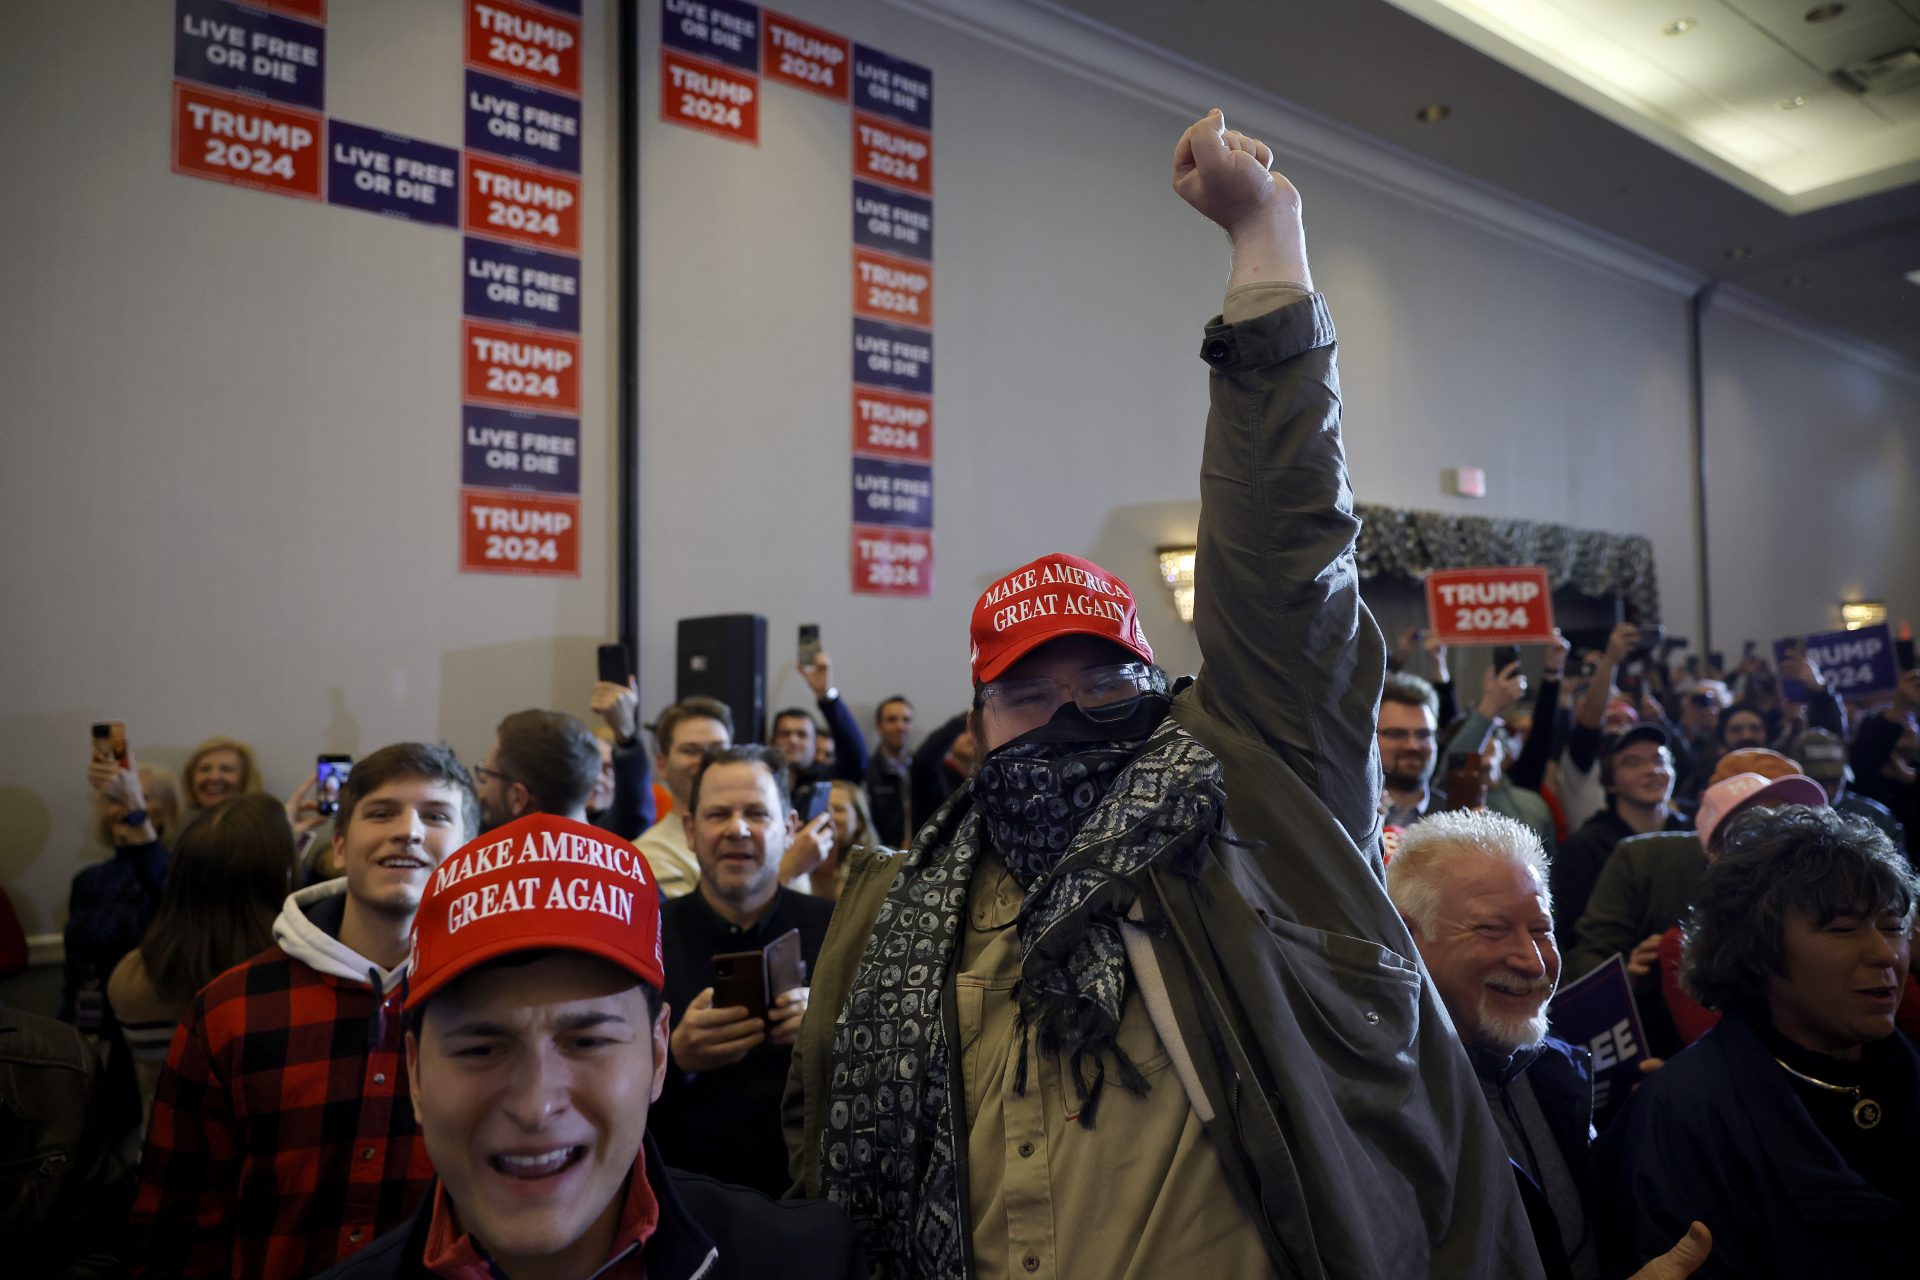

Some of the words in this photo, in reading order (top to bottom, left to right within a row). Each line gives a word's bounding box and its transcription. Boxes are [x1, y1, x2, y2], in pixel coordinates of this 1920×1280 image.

[475, 3, 573, 50] TRUMP
[666, 0, 706, 21] LIVE
[711, 9, 754, 37] FREE
[681, 19, 707, 41] OR
[711, 28, 741, 50] DIE
[183, 14, 245, 47] LIVE
[252, 32, 318, 66] FREE
[488, 36, 560, 76] 2024
[771, 24, 843, 64] TRUMP
[206, 44, 246, 70] OR
[252, 54, 296, 82] DIE
[780, 53, 833, 87] 2024
[856, 61, 889, 83] LIVE
[893, 73, 928, 98] FREE
[669, 64, 752, 104] TRUMP
[868, 82, 889, 102] OR
[893, 91, 917, 111] DIE
[187, 102, 312, 150] TRUMP
[470, 90, 518, 120] LIVE
[523, 107, 576, 136] FREE
[681, 94, 741, 128] 2024
[488, 118, 519, 141] OR
[524, 127, 560, 150] DIE
[860, 125, 926, 160] TRUMP
[204, 139, 295, 180] 2024
[334, 142, 389, 172] LIVE
[395, 158, 454, 188] FREE
[868, 151, 917, 181] 2024
[355, 169, 390, 196] OR
[396, 178, 435, 204] DIE
[473, 169, 572, 211] TRUMP
[487, 200, 559, 236] 2024
[856, 197, 889, 219] LIVE
[893, 207, 928, 230] FREE
[868, 217, 889, 236] OR
[893, 225, 917, 243] DIE
[469, 258, 518, 284] LIVE
[522, 269, 575, 295] FREE
[858, 262, 927, 292] TRUMP
[486, 282, 518, 305] OR
[523, 289, 558, 311] DIE
[868, 285, 918, 314] 2024
[472, 337, 572, 371] TRUMP
[856, 335, 889, 357] LIVE
[893, 342, 928, 363] FREE
[868, 354, 889, 373] OR
[893, 359, 918, 377] DIE
[487, 367, 558, 398] 2024
[858, 400, 927, 425] TRUMP
[468, 426, 516, 450] LIVE
[522, 433, 574, 456] FREE
[868, 423, 918, 449] 2024
[485, 449, 517, 470] OR
[523, 455, 558, 474] DIE
[856, 473, 889, 493] LIVE
[893, 478, 928, 497] FREE
[868, 493, 889, 510] OR
[893, 496, 918, 512] DIE
[471, 505, 571, 534] TRUMP
[485, 535, 557, 560] 2024
[858, 539, 926, 562] TRUMP
[868, 562, 918, 584] 2024
[983, 569, 1037, 609] MAKE
[1041, 563, 1131, 600] AMERICA
[1437, 581, 1539, 606] TRUMP
[993, 593, 1059, 632] GREAT
[1064, 593, 1126, 625] AGAIN
[1456, 606, 1529, 631] 2024
[1806, 638, 1882, 665] RUMP
[1824, 663, 1874, 687] 024
[432, 837, 513, 898] MAKE
[517, 831, 647, 886] AMERICA
[448, 877, 540, 935] GREAT
[544, 877, 634, 926] AGAIN
[1590, 1017, 1638, 1072] EE
